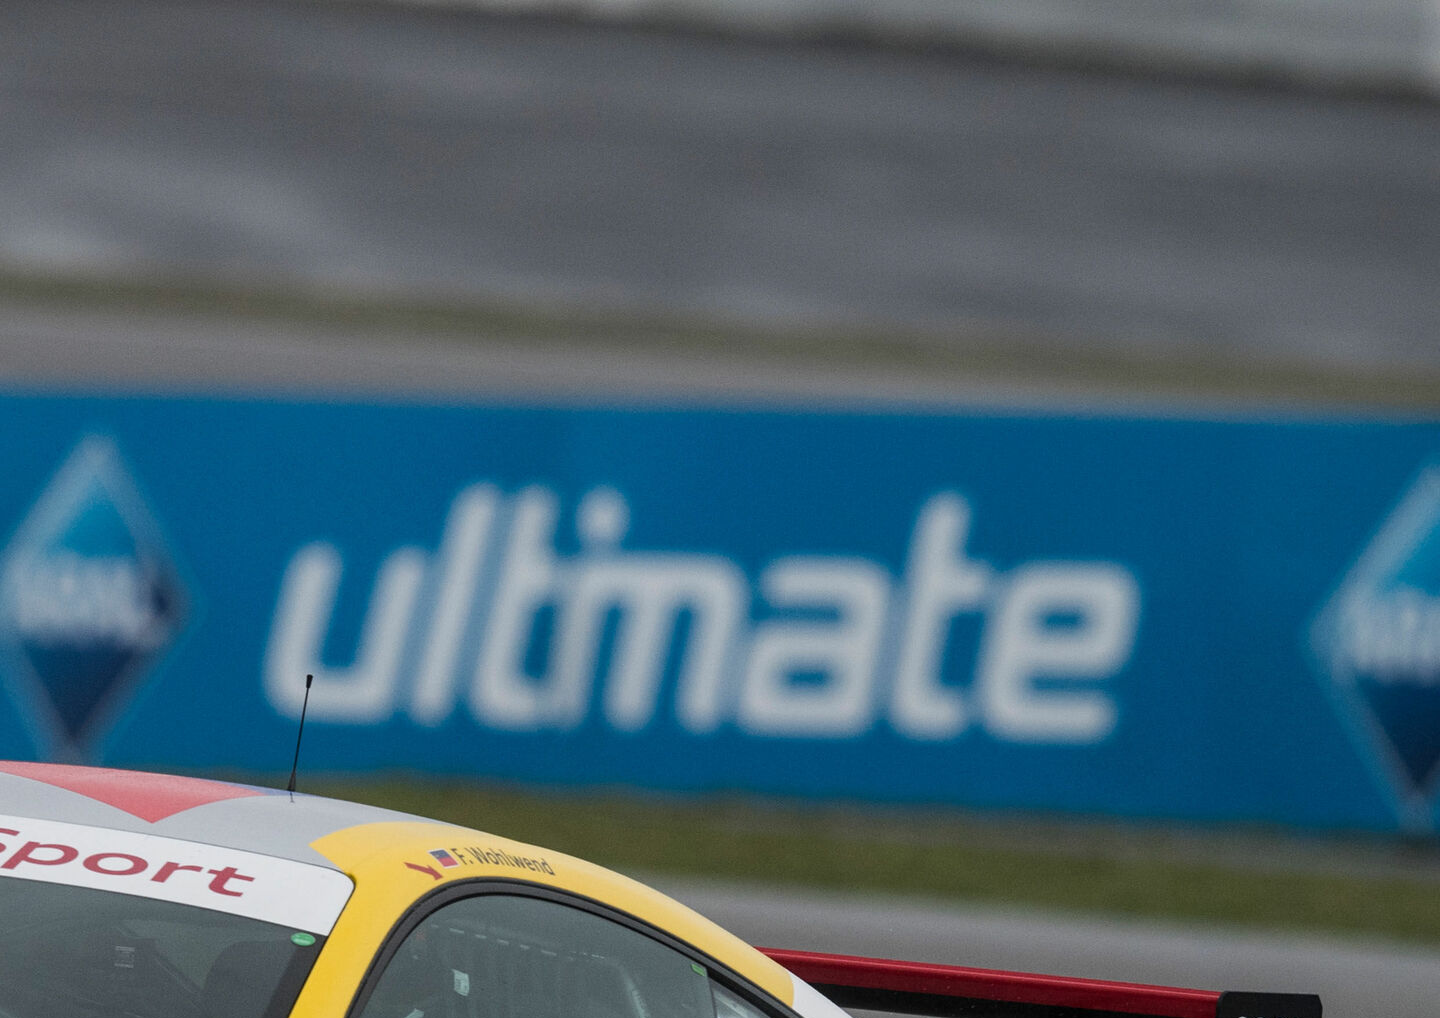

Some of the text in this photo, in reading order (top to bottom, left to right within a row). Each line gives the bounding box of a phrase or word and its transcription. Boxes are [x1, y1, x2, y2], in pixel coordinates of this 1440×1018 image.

[263, 480, 1142, 744] ultimate
[450, 847, 556, 876] F. Wohlwend
